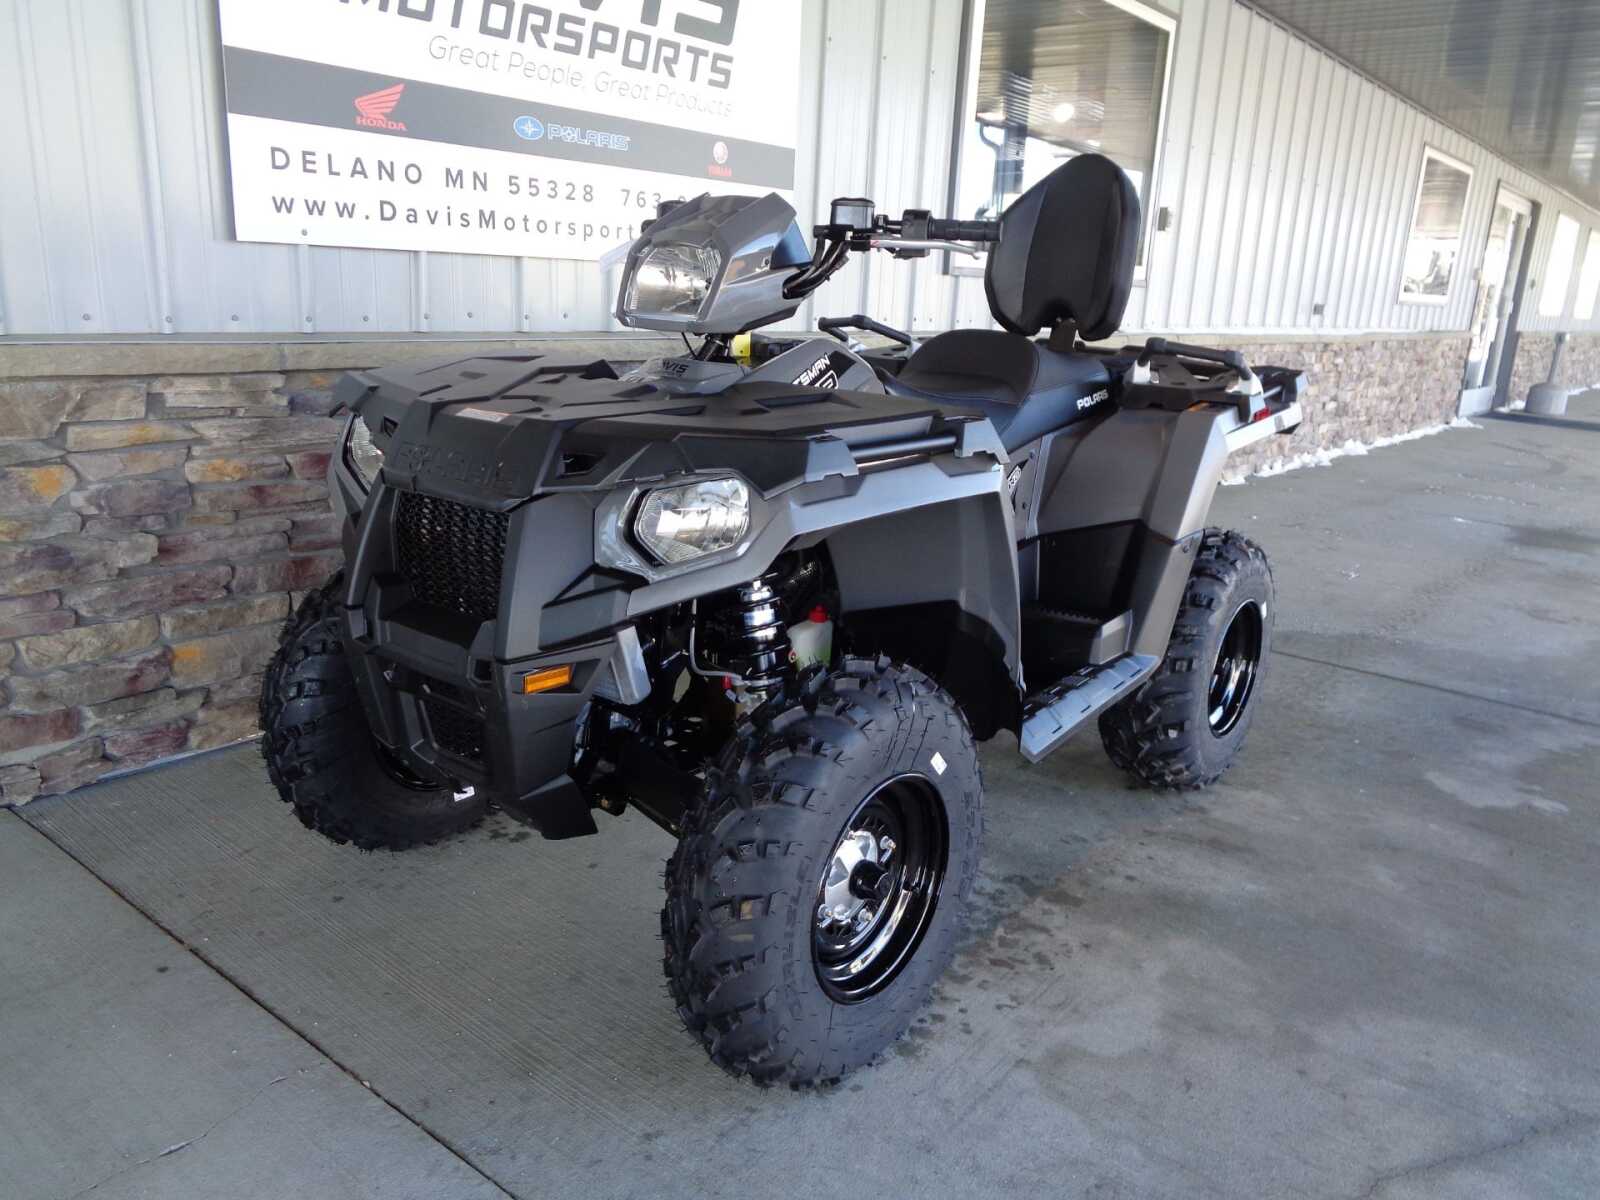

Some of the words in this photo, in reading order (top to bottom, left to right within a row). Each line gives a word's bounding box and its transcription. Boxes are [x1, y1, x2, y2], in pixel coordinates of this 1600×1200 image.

[428, 34, 500, 72] Great
[594, 70, 649, 101] Great
[356, 115, 408, 132] HONDA
[547, 122, 630, 151] POLARIS
[270, 146, 423, 185] DELANO
[444, 167, 489, 192] MN
[507, 175, 594, 202] 55328
[620, 189, 662, 209] 763
